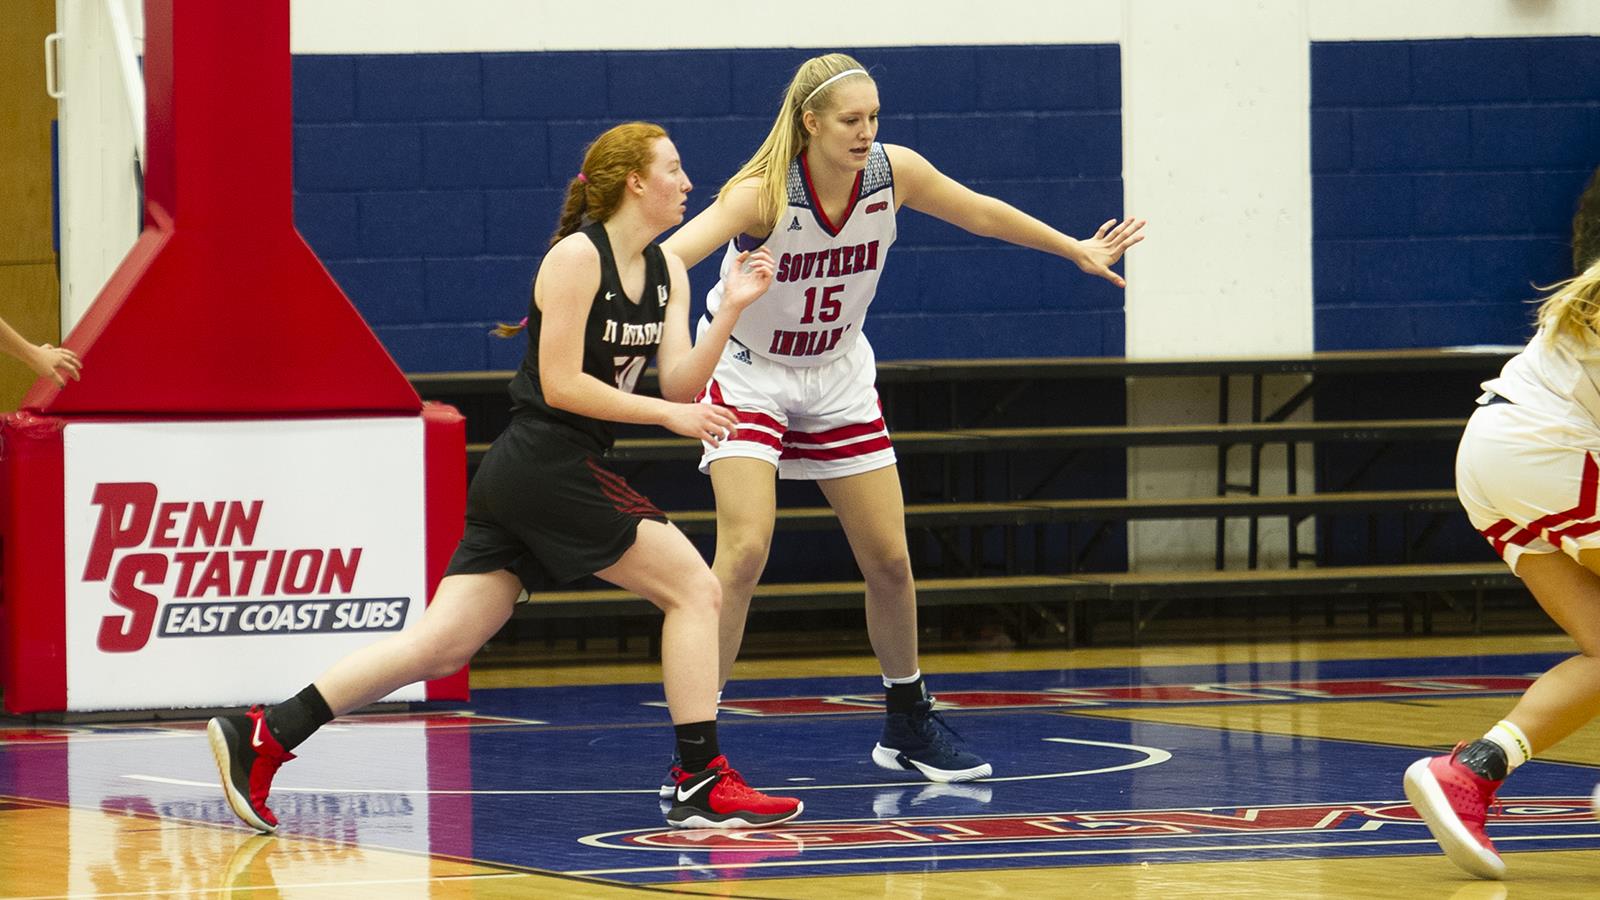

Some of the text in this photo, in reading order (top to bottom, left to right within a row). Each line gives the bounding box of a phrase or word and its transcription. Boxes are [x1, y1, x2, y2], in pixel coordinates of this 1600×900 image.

[776, 240, 879, 282] SOUTHERN
[800, 284, 845, 324] 15
[769, 323, 852, 357] INDIA
[82, 482, 264, 582] PENN
[96, 547, 363, 653] STATION
[164, 601, 403, 633] EAST COAST SUBS
